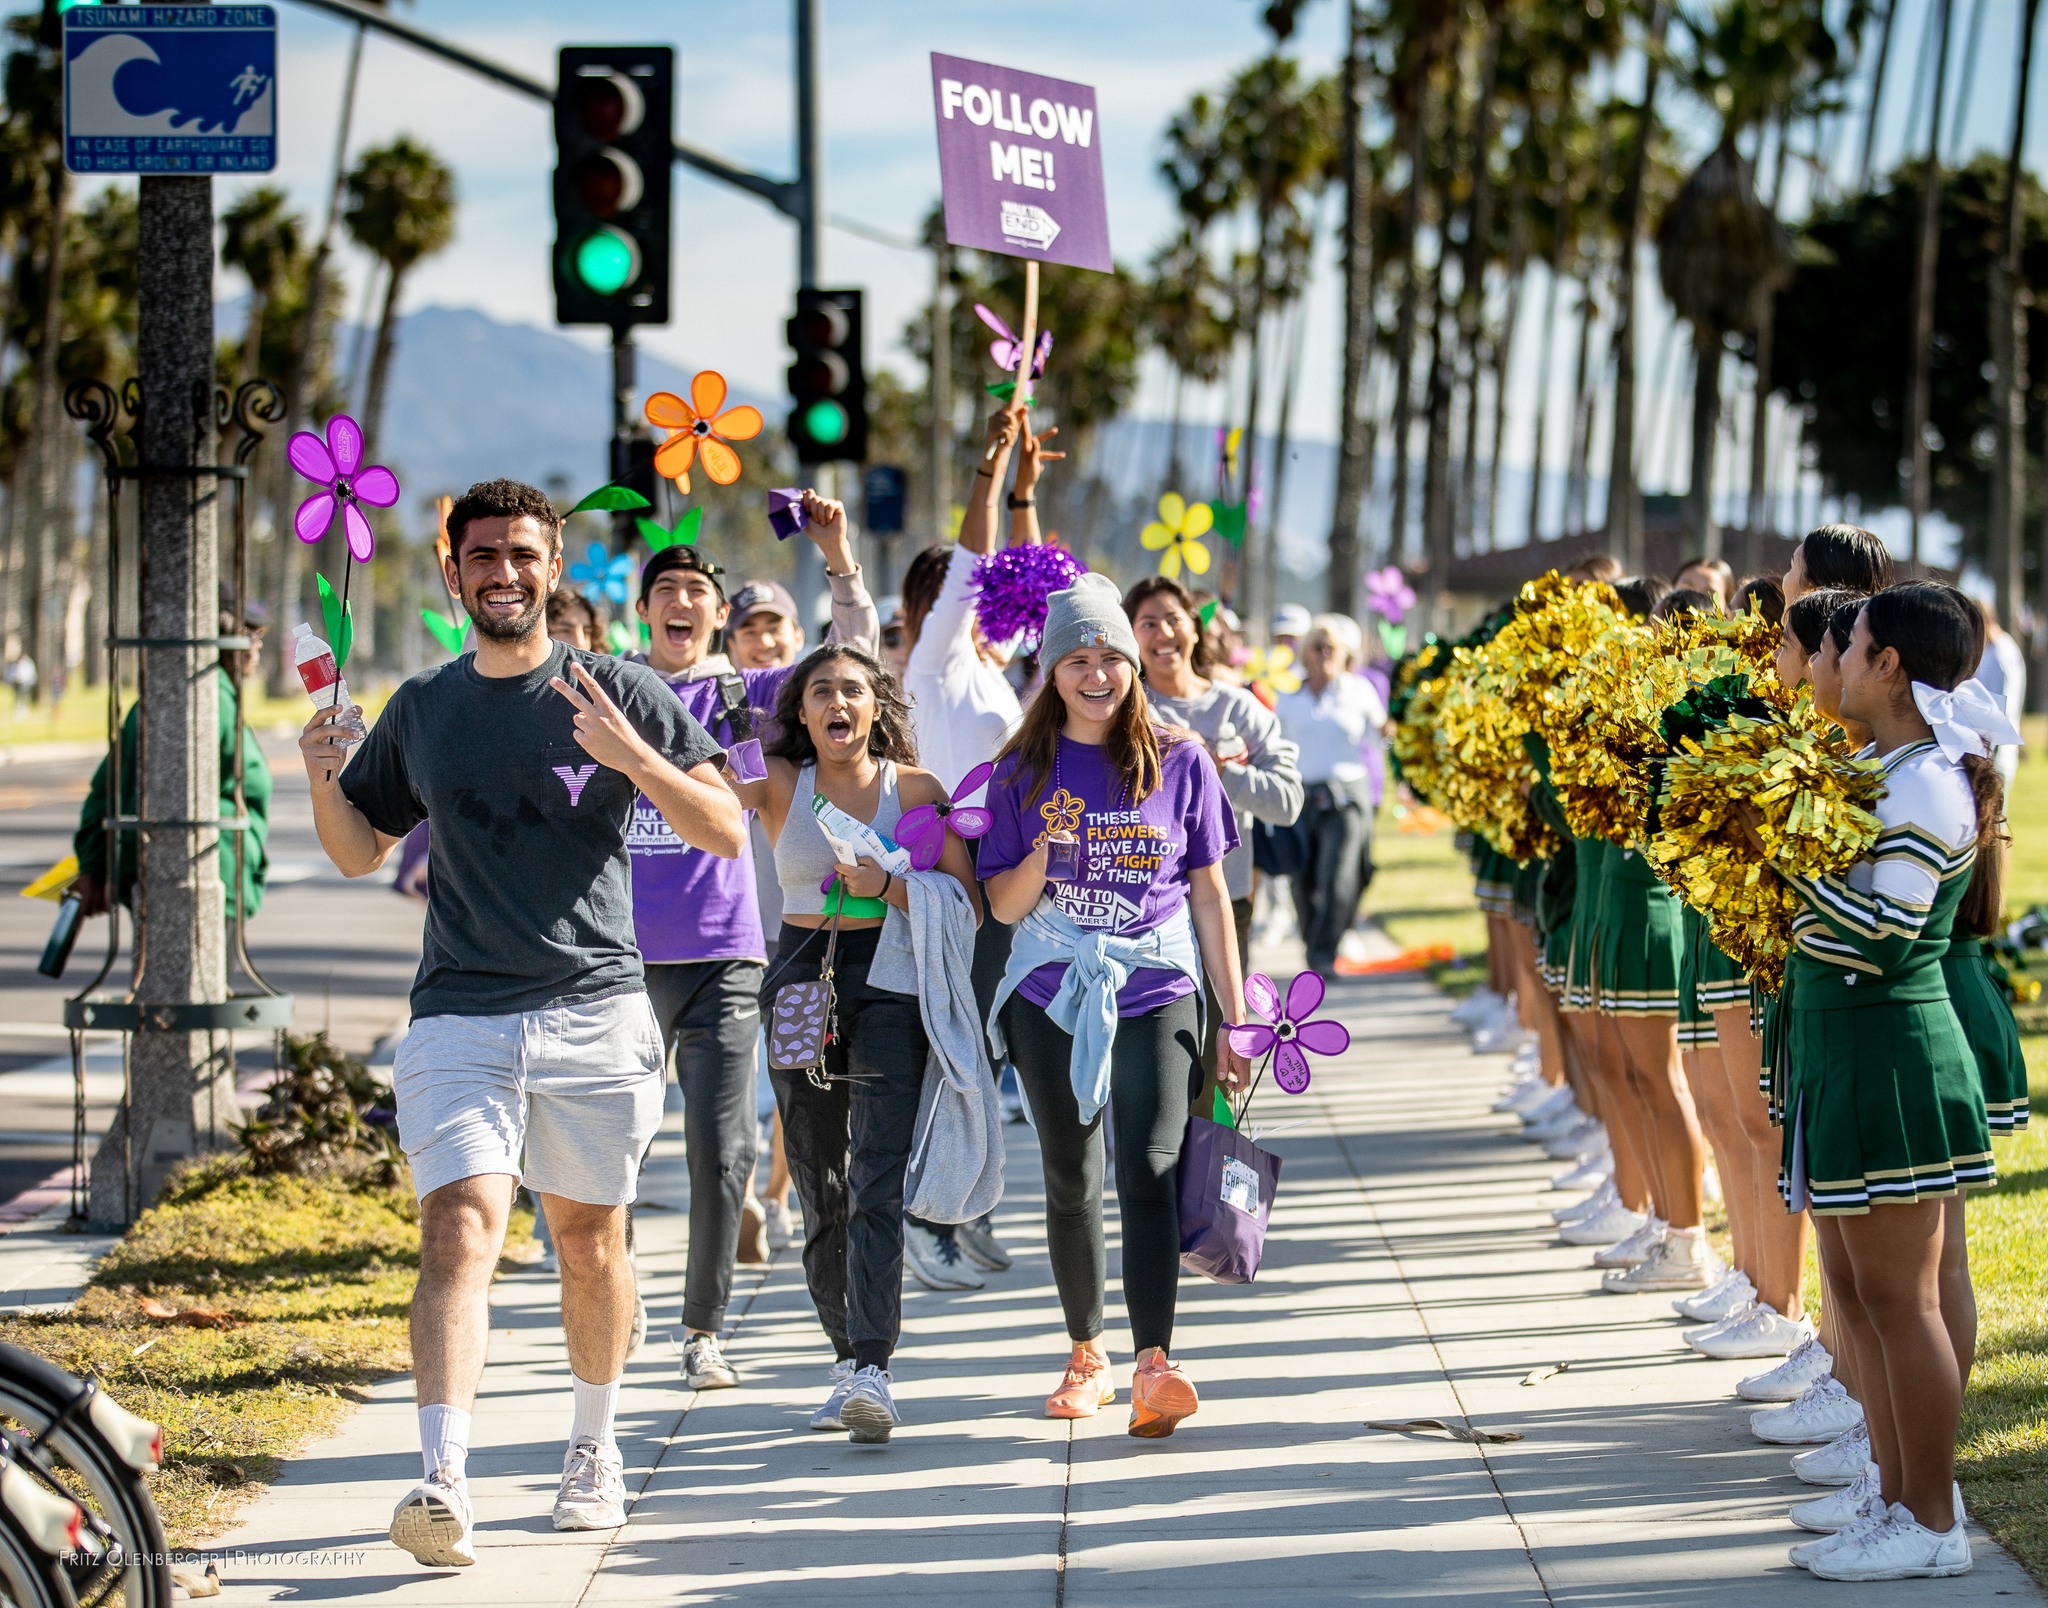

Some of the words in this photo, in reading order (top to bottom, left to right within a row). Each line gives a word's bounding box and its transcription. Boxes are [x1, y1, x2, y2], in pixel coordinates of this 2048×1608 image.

[76, 9, 147, 25] TSUNAMI
[153, 9, 217, 25] HAZARD
[223, 9, 266, 25] ZONE
[940, 78, 1094, 148] FOLLOW
[75, 139, 90, 152] IN
[94, 139, 129, 152] CASE
[135, 139, 151, 152] OF
[157, 139, 244, 152] EARTHQUAKE
[75, 156, 91, 169] TO
[96, 156, 129, 169] HIGH
[135, 156, 191, 169] GROUND
[197, 156, 213, 169] OR
[219, 156, 269, 169] INLAND
[989, 140, 1057, 192] ME!
[1005, 215, 1041, 232] END
[552, 764, 599, 807] Y
[633, 808, 659, 821] ALK
[1086, 811, 1140, 826] THESE
[1087, 825, 1168, 841] FLOWERS
[1088, 841, 1132, 857] HAVE
[1136, 841, 1148, 855] A
[1151, 842, 1179, 857] LOT
[1088, 856, 1111, 871] OF
[1114, 855, 1163, 870] FIGHT
[1086, 871, 1103, 882] IN
[1106, 869, 1152, 885] THEM
[1093, 889, 1113, 904] TO
[1055, 897, 1110, 917] END
[1069, 916, 1108, 925] EIMER'S
